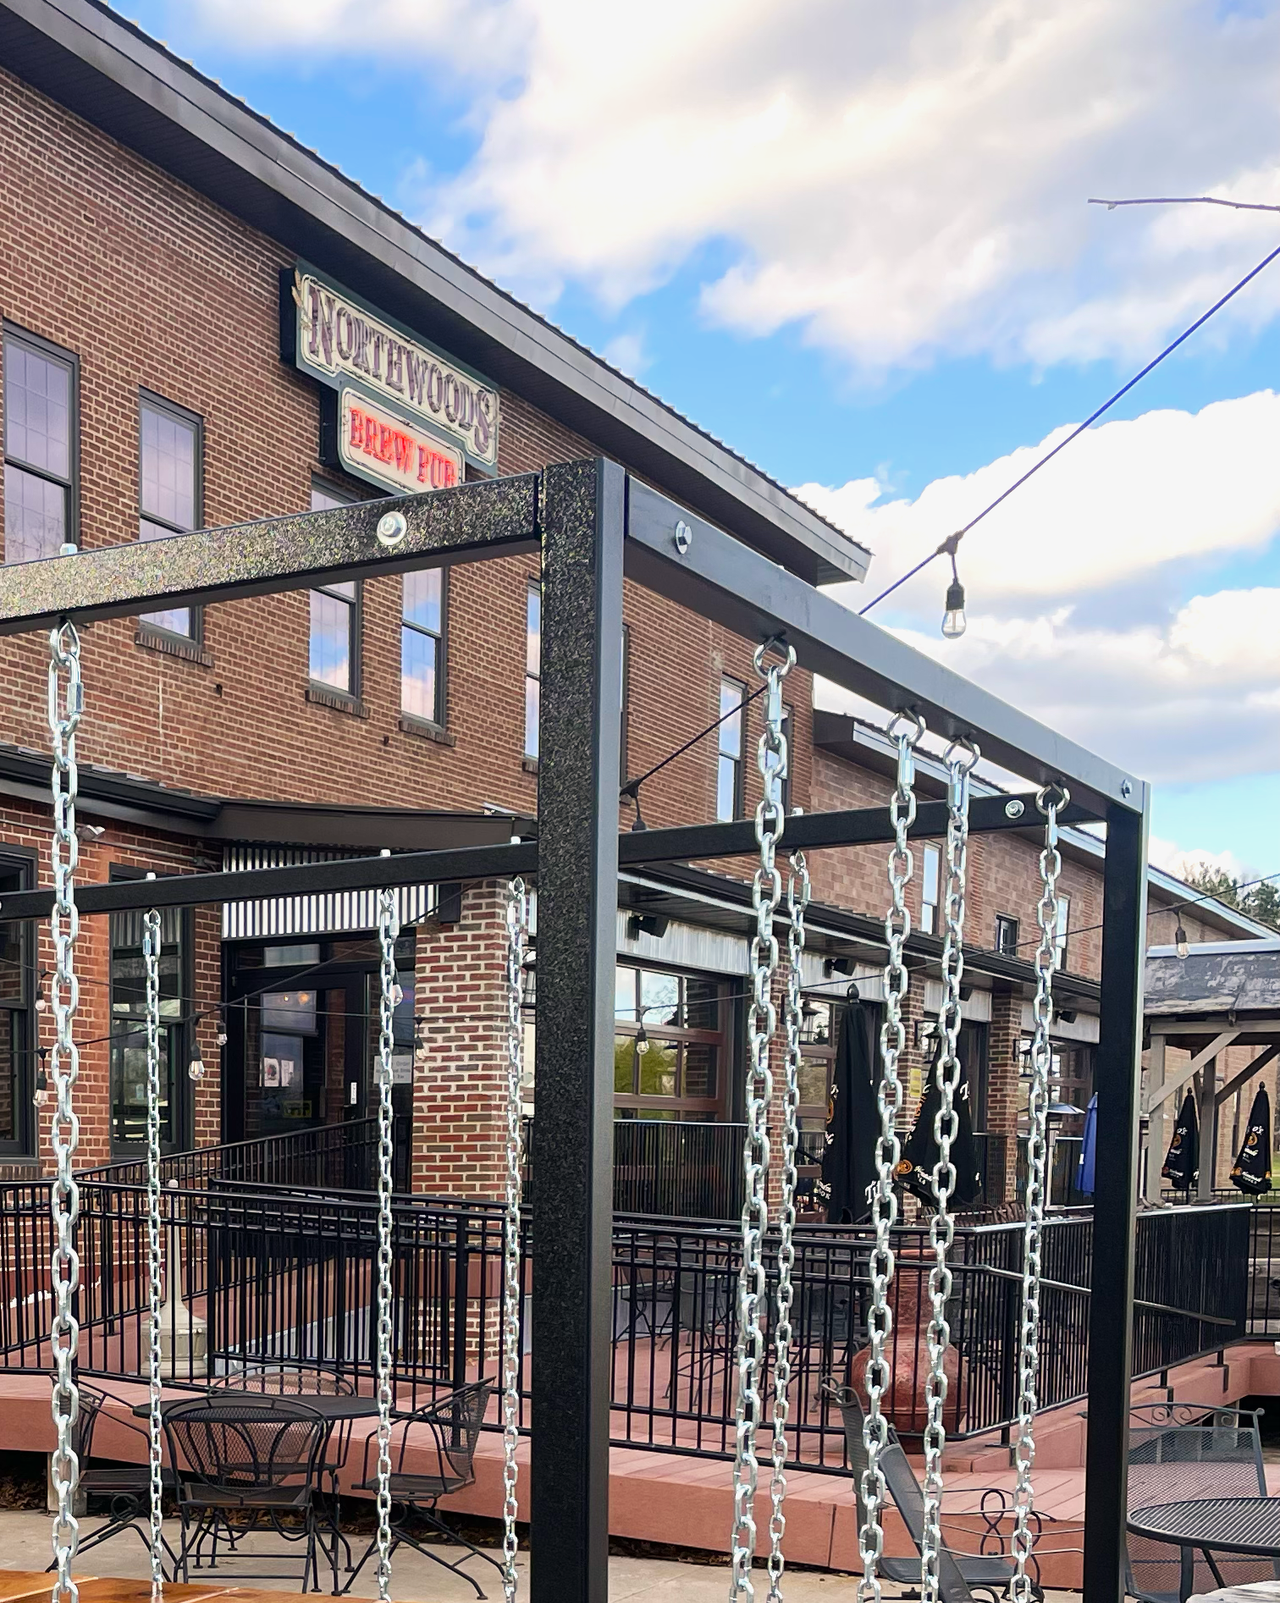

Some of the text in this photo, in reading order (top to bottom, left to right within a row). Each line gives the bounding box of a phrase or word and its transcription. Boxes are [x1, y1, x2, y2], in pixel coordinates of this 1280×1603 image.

[306, 285, 493, 455] NORTHWOODS
[349, 406, 459, 488] BREW PUB
